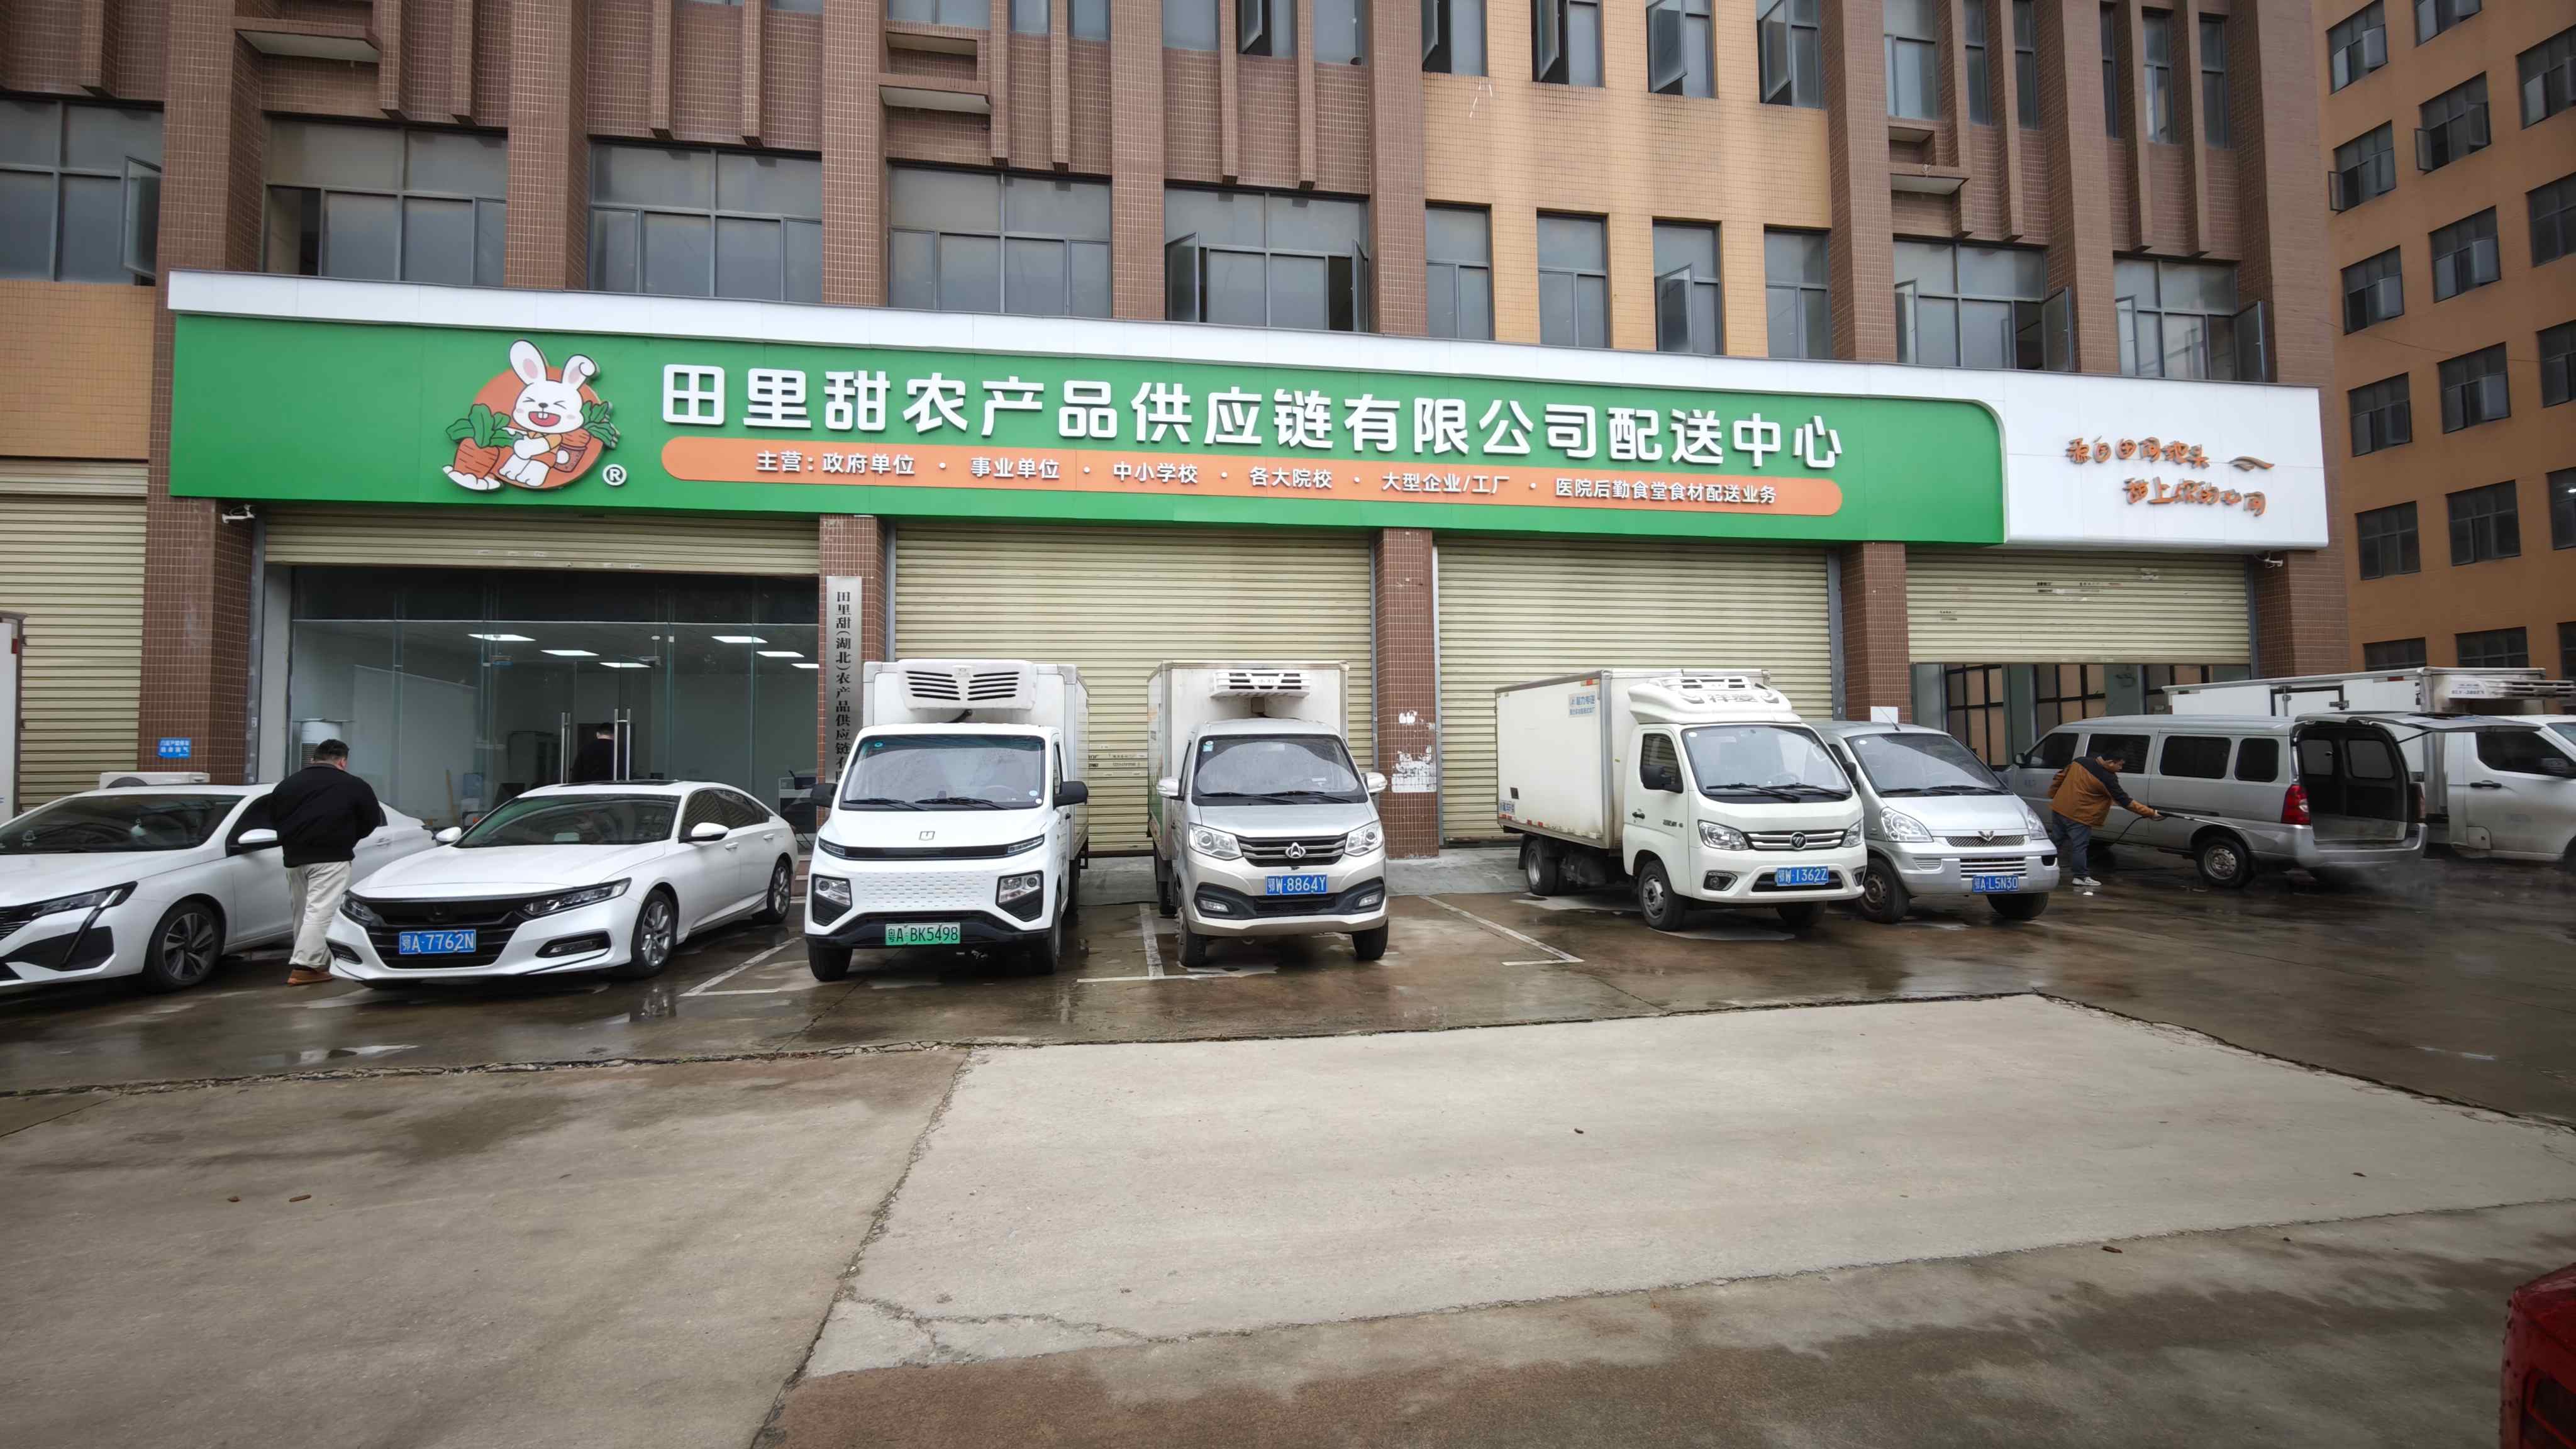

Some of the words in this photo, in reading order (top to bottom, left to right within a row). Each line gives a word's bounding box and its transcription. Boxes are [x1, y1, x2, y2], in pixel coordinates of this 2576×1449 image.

[662, 363, 1843, 470] 田里甜农产品供应链有限公司配送中心
[970, 456, 1061, 480] 事业单位
[1112, 460, 1199, 485] 中小学校
[1249, 465, 1333, 491] 各大院校
[1382, 470, 1511, 496] 大型企业/工厂
[1555, 476, 1777, 505] 医院后勤食堂食材配送业务
